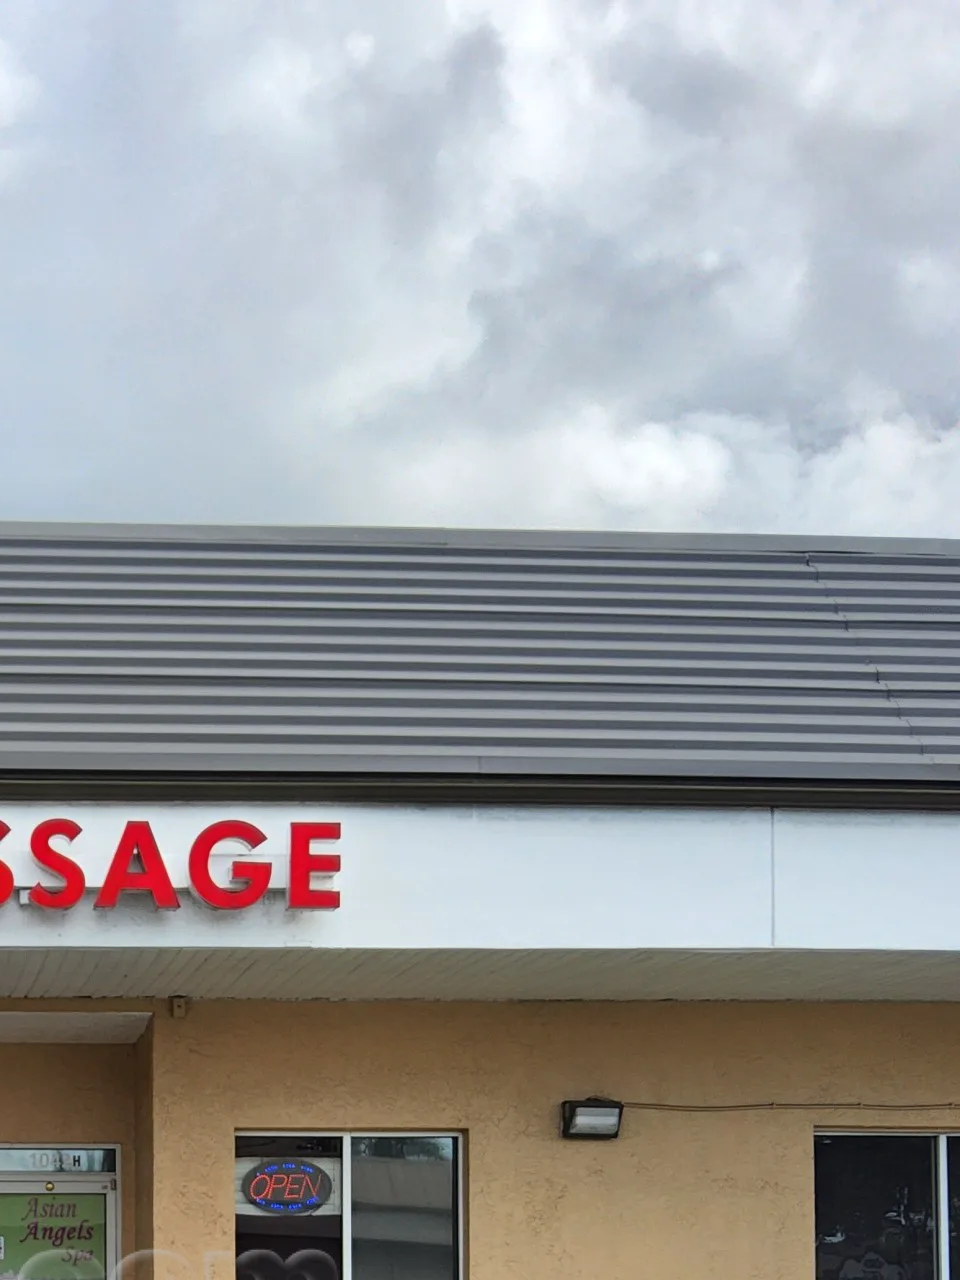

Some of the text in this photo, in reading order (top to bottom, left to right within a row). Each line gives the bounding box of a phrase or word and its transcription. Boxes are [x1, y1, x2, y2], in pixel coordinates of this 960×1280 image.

[73, 1155, 81, 1167] H
[250, 1173, 322, 1200] OPEN
[21, 1197, 78, 1221] Asian
[19, 1219, 94, 1247] Angels
[61, 1245, 94, 1267] Spa
